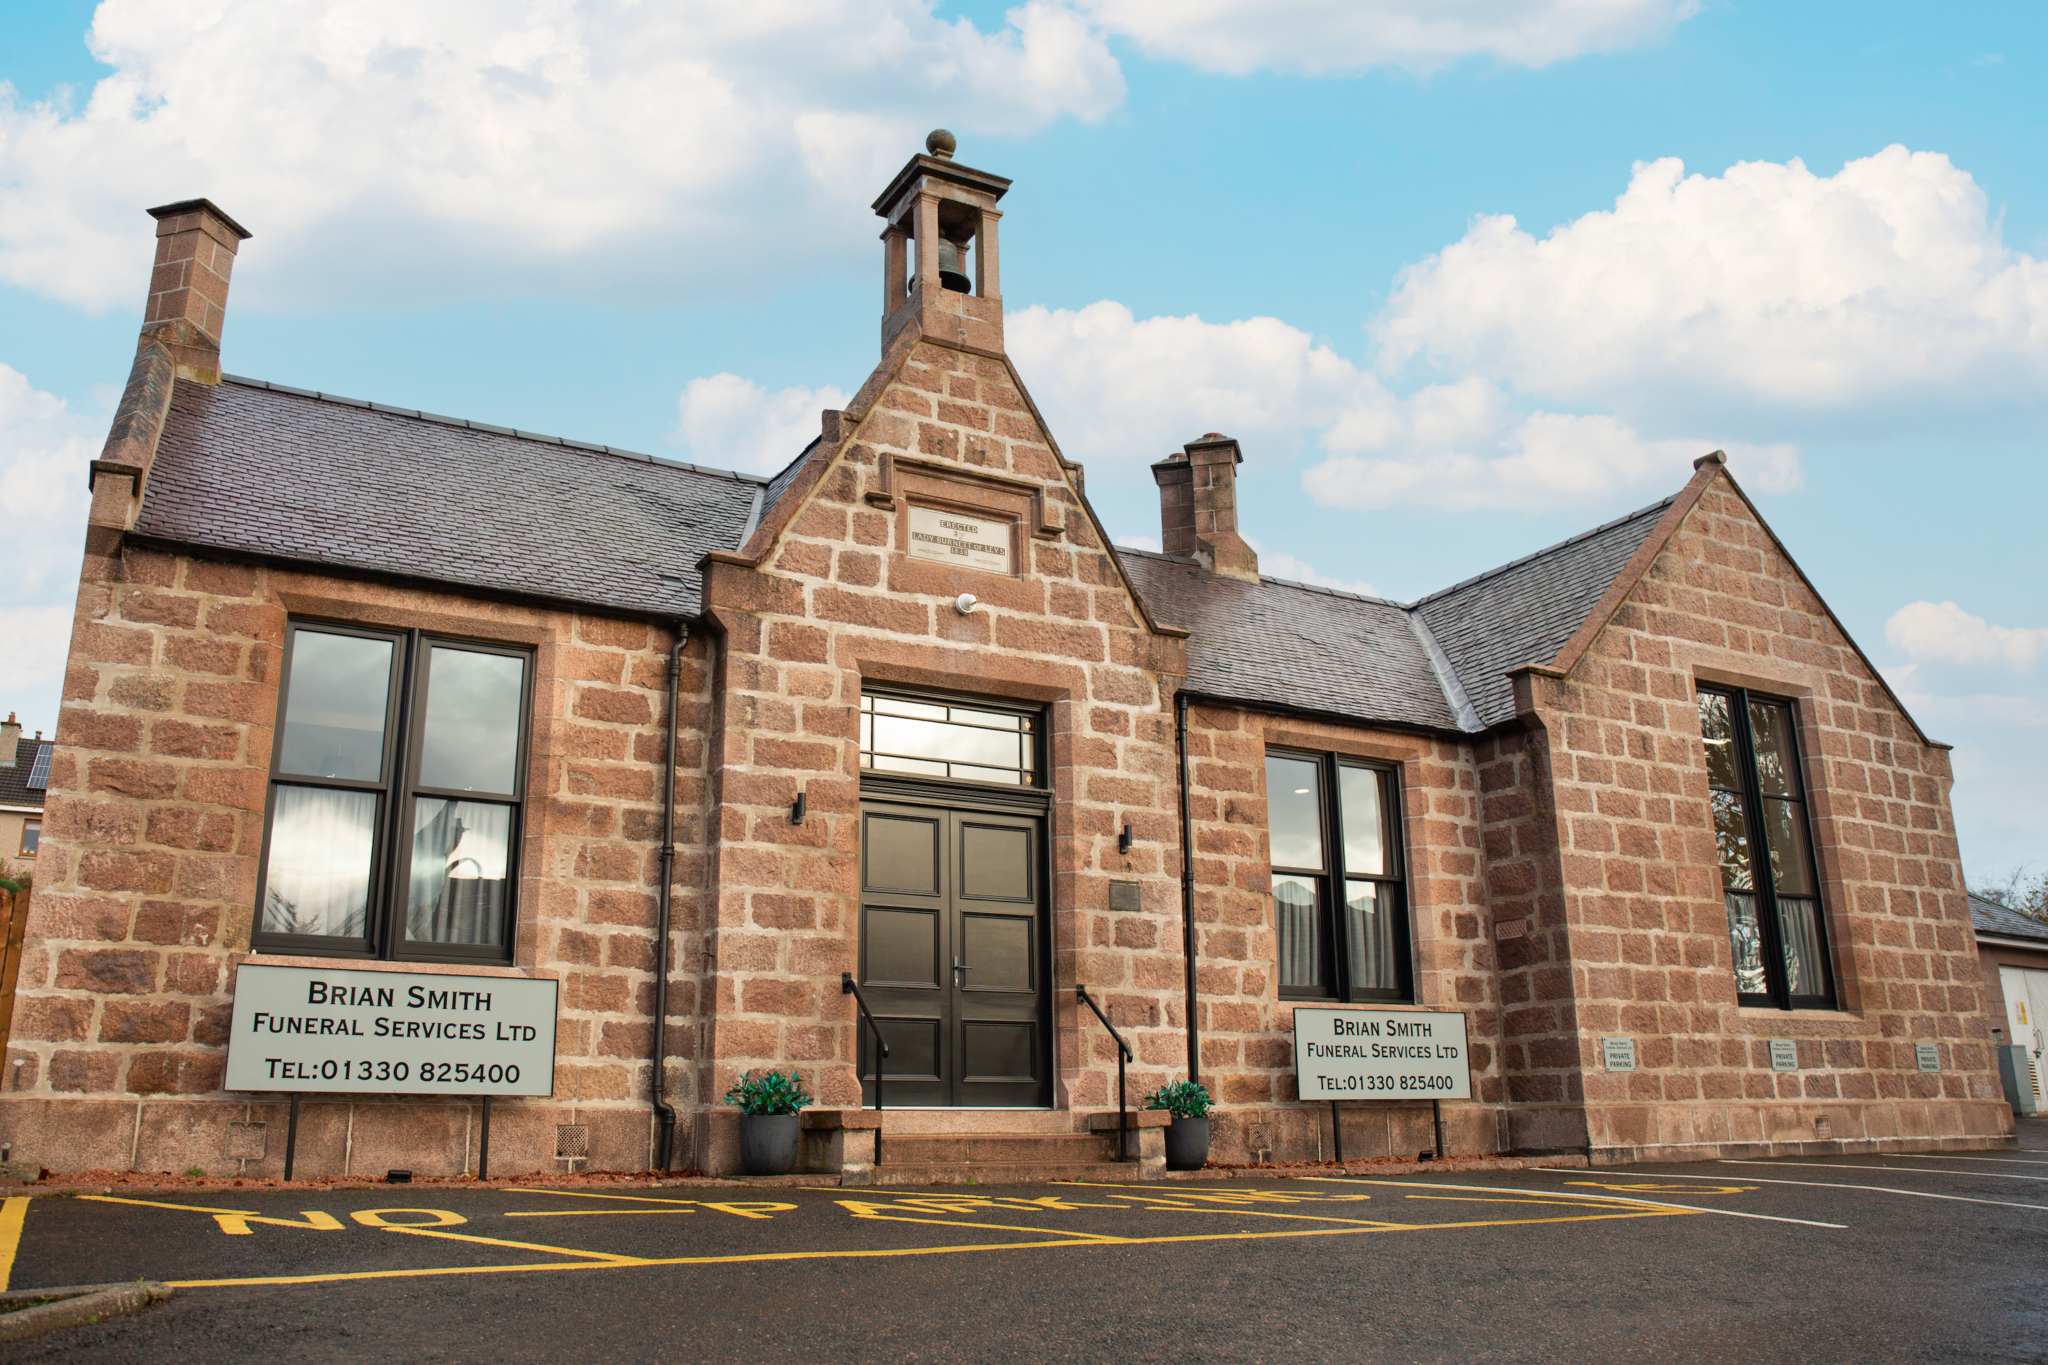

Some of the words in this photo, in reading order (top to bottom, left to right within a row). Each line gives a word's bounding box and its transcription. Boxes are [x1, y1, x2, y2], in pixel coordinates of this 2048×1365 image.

[940, 520, 977, 533] ERECTED
[912, 532, 933, 543] LADY
[936, 536, 972, 550] BURNETT
[984, 545, 1005, 556] LEYS
[308, 981, 394, 1007] BRIAN
[407, 986, 491, 1011] SMITH
[253, 1013, 363, 1036] FUNERAL
[374, 1017, 485, 1040] SERVICES
[496, 1022, 536, 1041] LTD
[1334, 1019, 1379, 1036] BRIAN
[1387, 1020, 1431, 1037] SMITH
[1308, 1043, 1367, 1057] FUNERAL
[1372, 1044, 1431, 1058] SERVICES
[1436, 1045, 1458, 1058] LTD
[265, 1058, 409, 1081] TEL:01330
[420, 1063, 520, 1083] 825400
[1318, 1076, 1394, 1090] TEL:01330
[1400, 1076, 1453, 1090] 825400
[212, 1208, 469, 1236] NO
[697, 1190, 1372, 1219] PARKING
